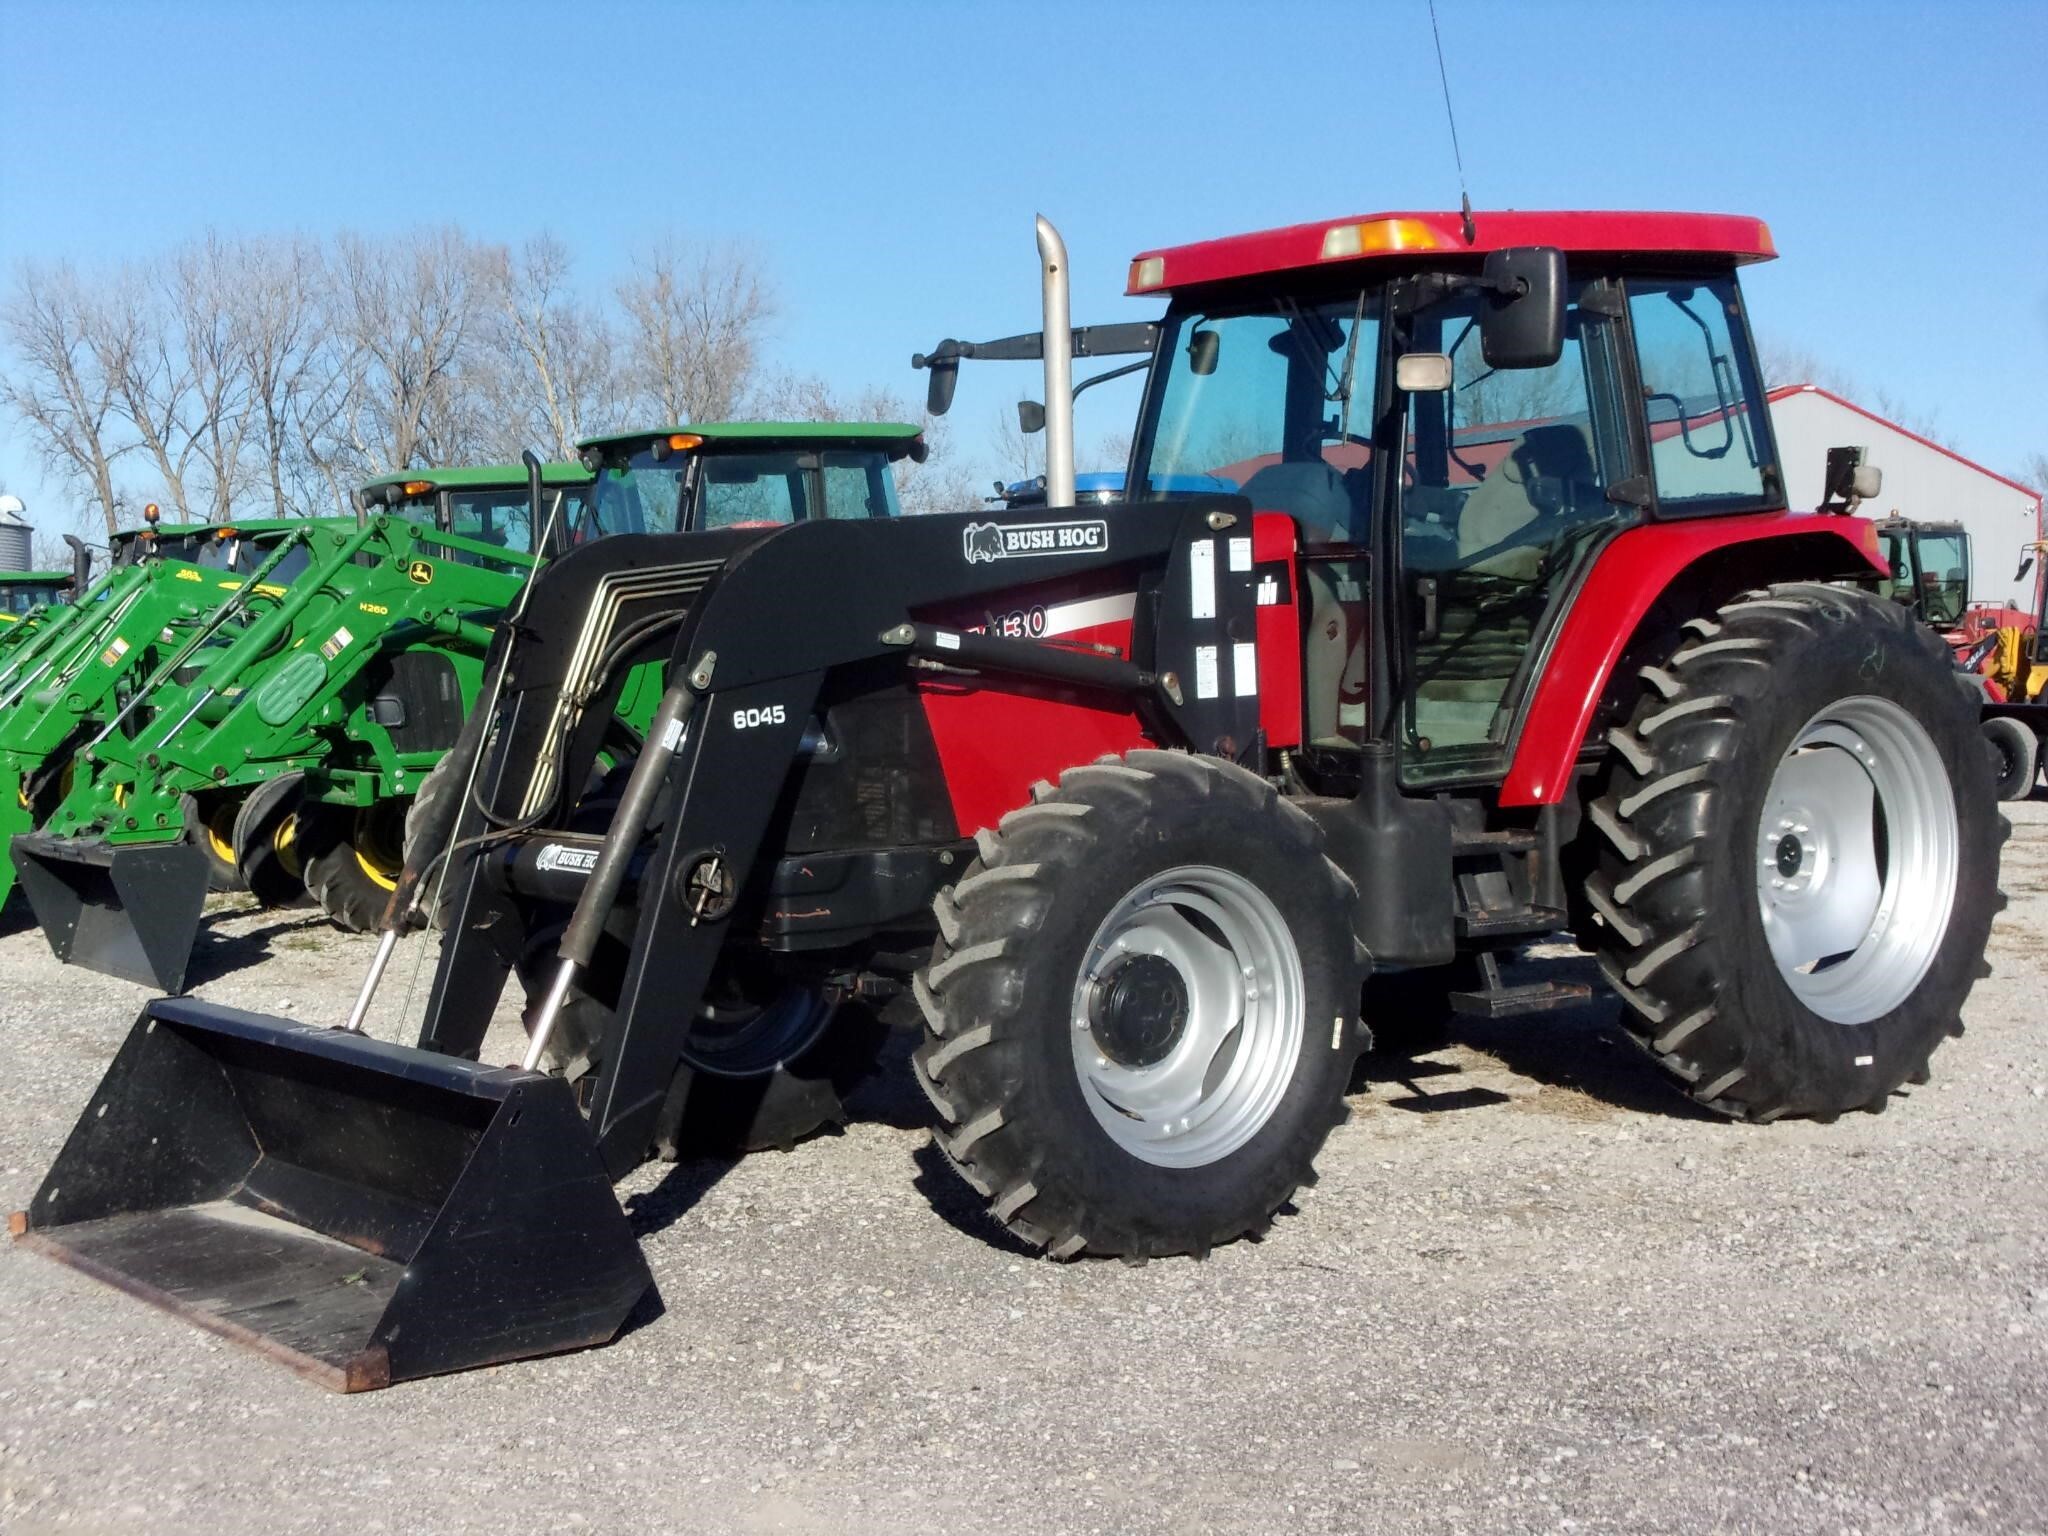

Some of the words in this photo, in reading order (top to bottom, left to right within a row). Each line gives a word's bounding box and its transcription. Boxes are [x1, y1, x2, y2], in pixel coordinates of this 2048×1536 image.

[1006, 531, 1055, 550] BUSH
[1058, 527, 1100, 547] HOG
[360, 602, 388, 615] H260
[733, 704, 786, 729] 6045
[557, 851, 585, 867] BUSH
[582, 854, 599, 868] HO
